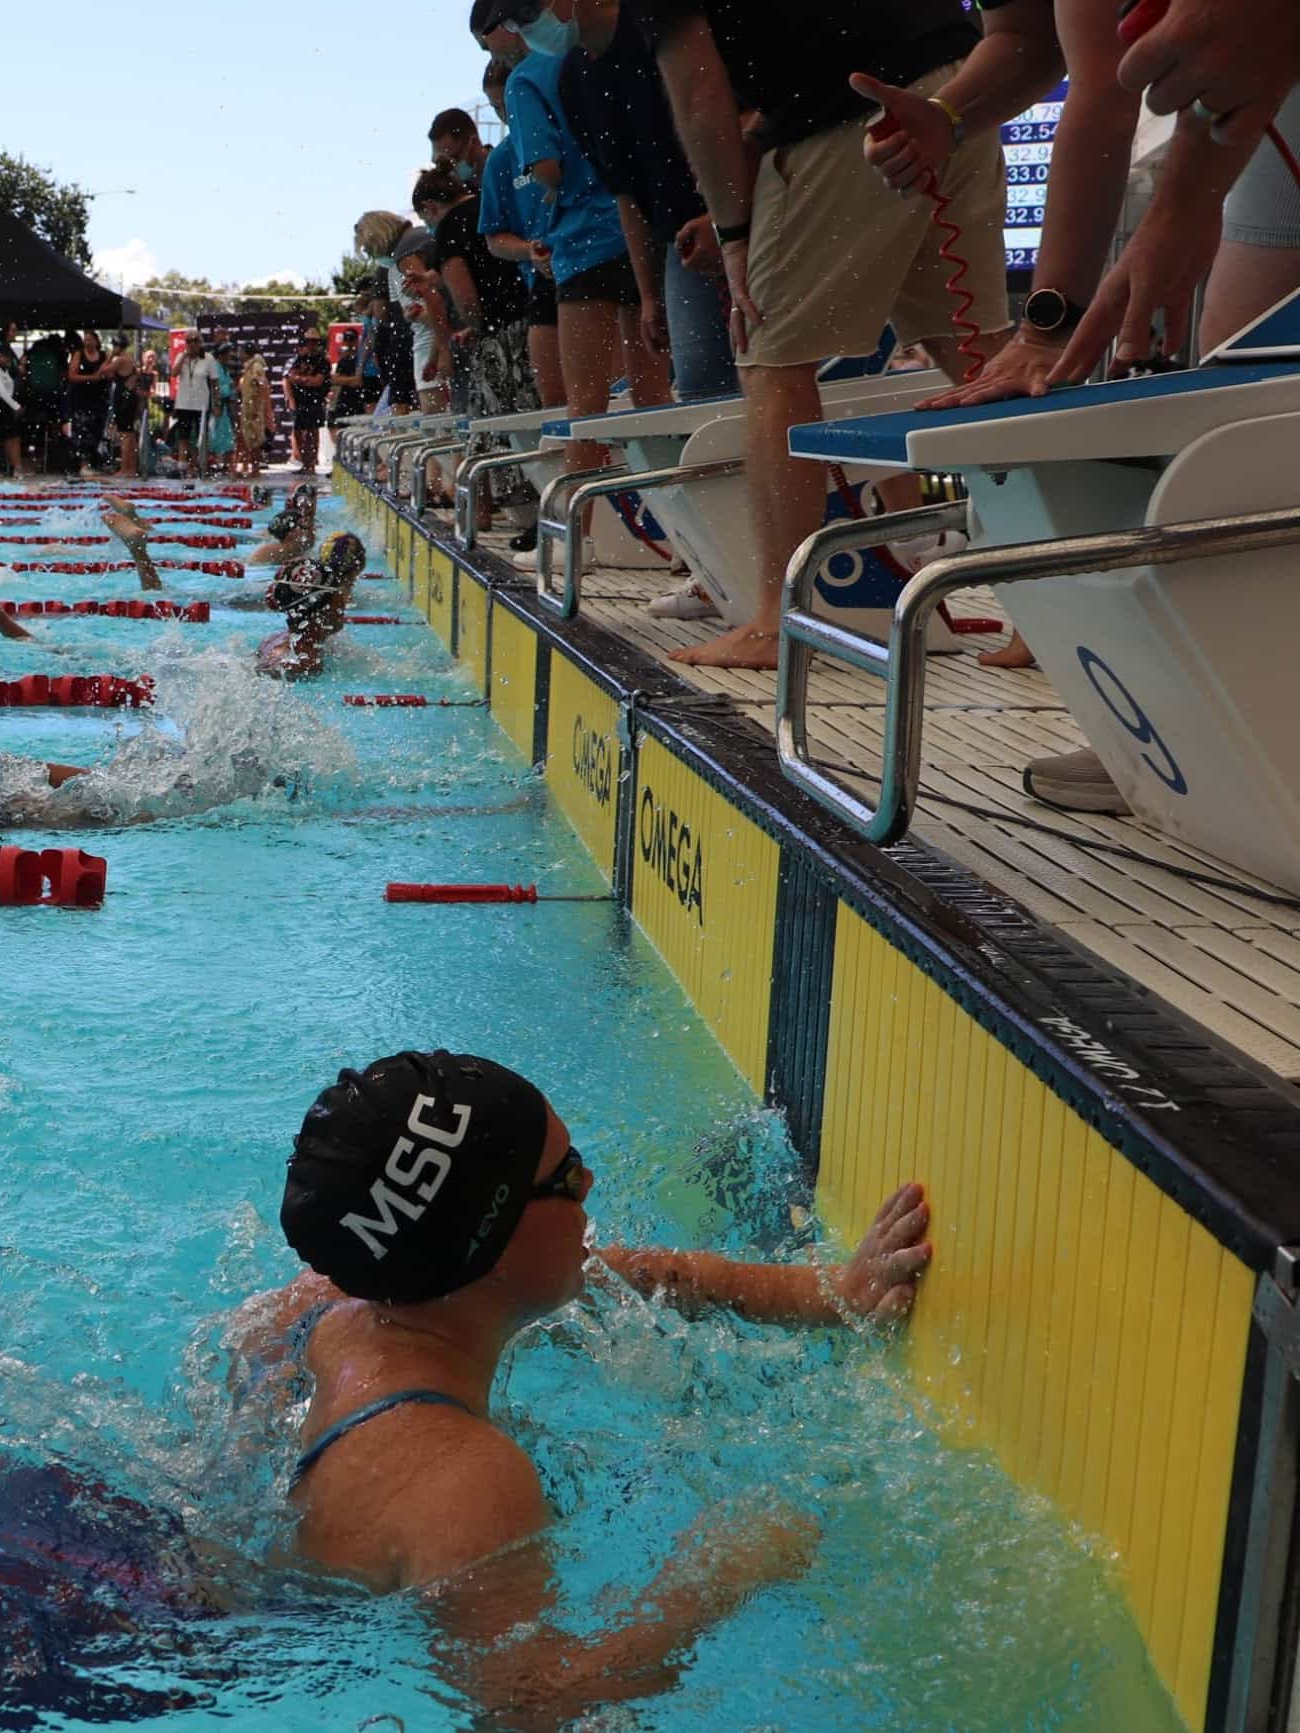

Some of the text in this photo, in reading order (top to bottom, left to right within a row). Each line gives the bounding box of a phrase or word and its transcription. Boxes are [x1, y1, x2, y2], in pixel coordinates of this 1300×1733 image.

[1005, 207, 1044, 224] 32.9
[1007, 165, 1047, 182] 33.0
[1076, 645, 1188, 796] 9
[640, 785, 703, 926] OMEGA
[339, 1093, 472, 1261] MSC
